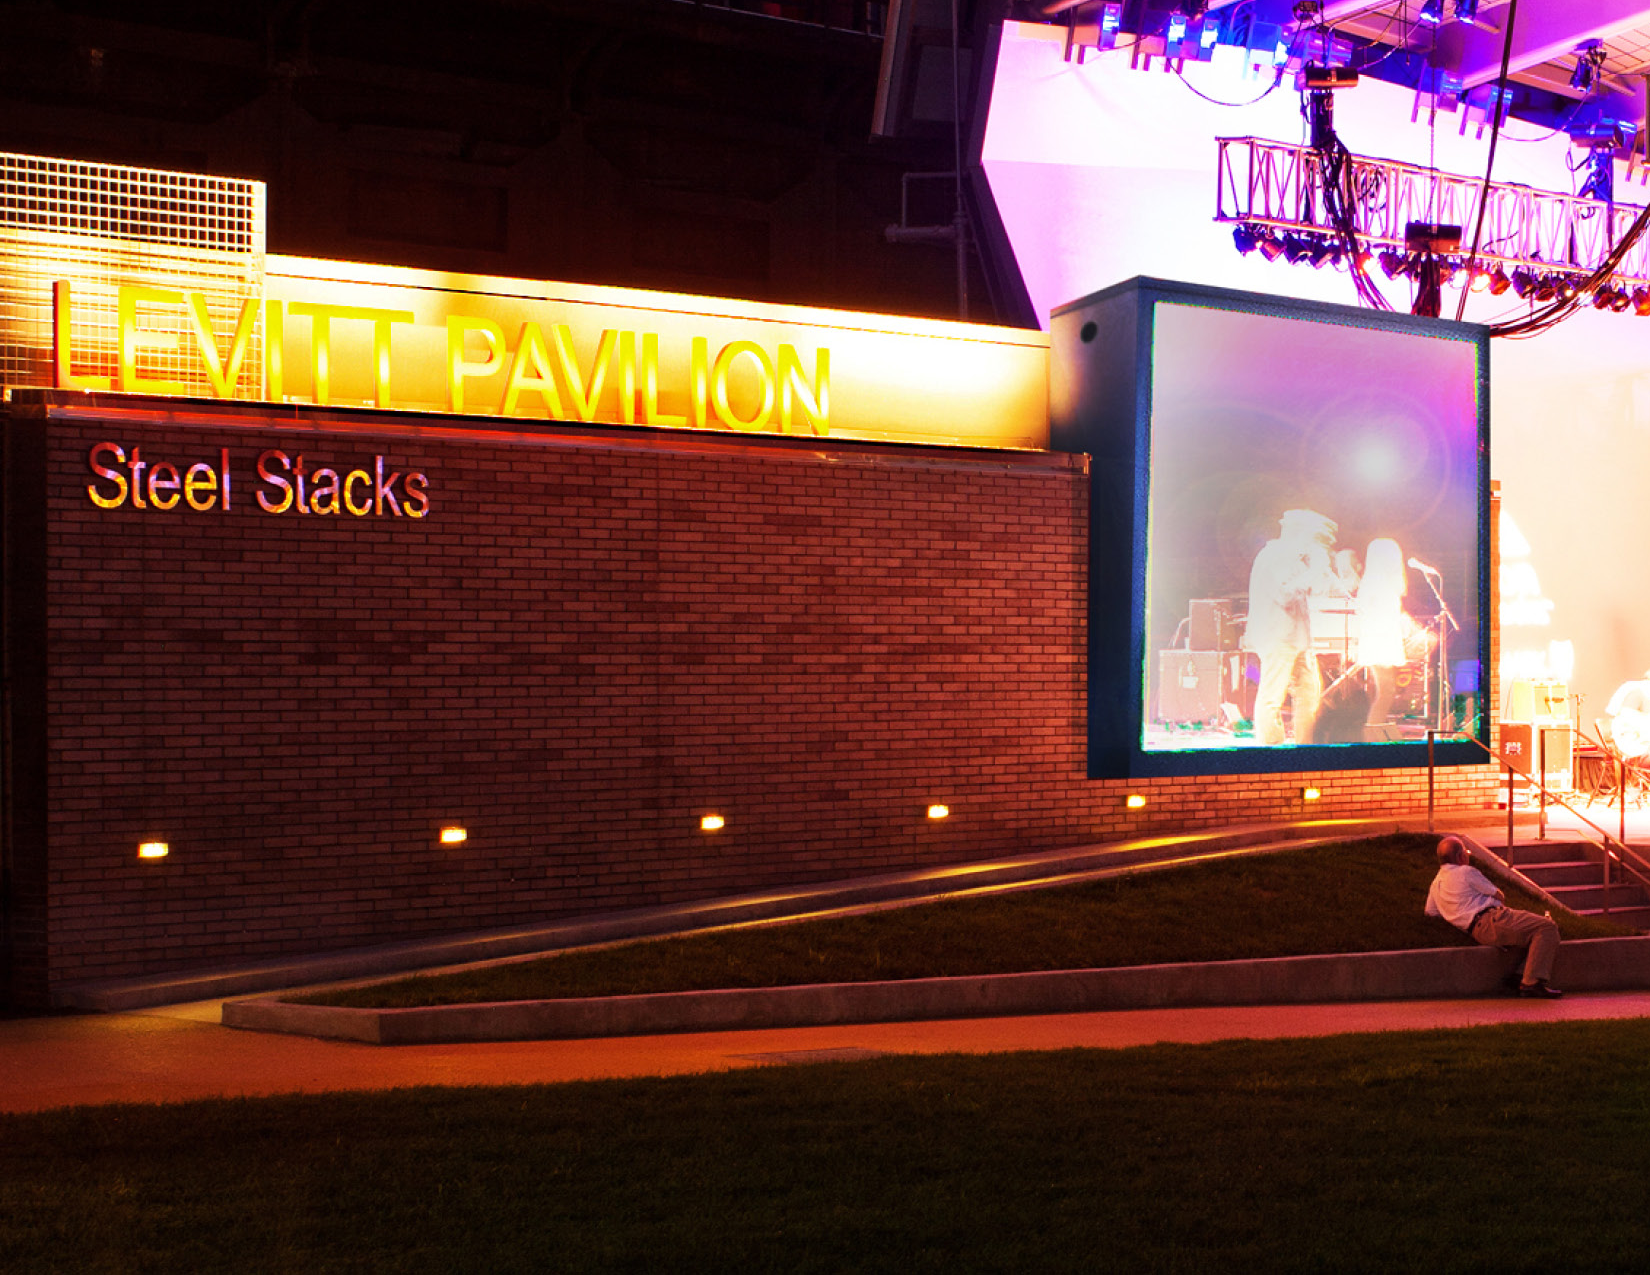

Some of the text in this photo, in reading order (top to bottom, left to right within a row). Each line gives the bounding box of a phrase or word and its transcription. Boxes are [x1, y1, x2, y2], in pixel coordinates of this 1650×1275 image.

[52, 279, 831, 437] LEVITT PAVILION
[87, 441, 430, 519] Steel Stacks
